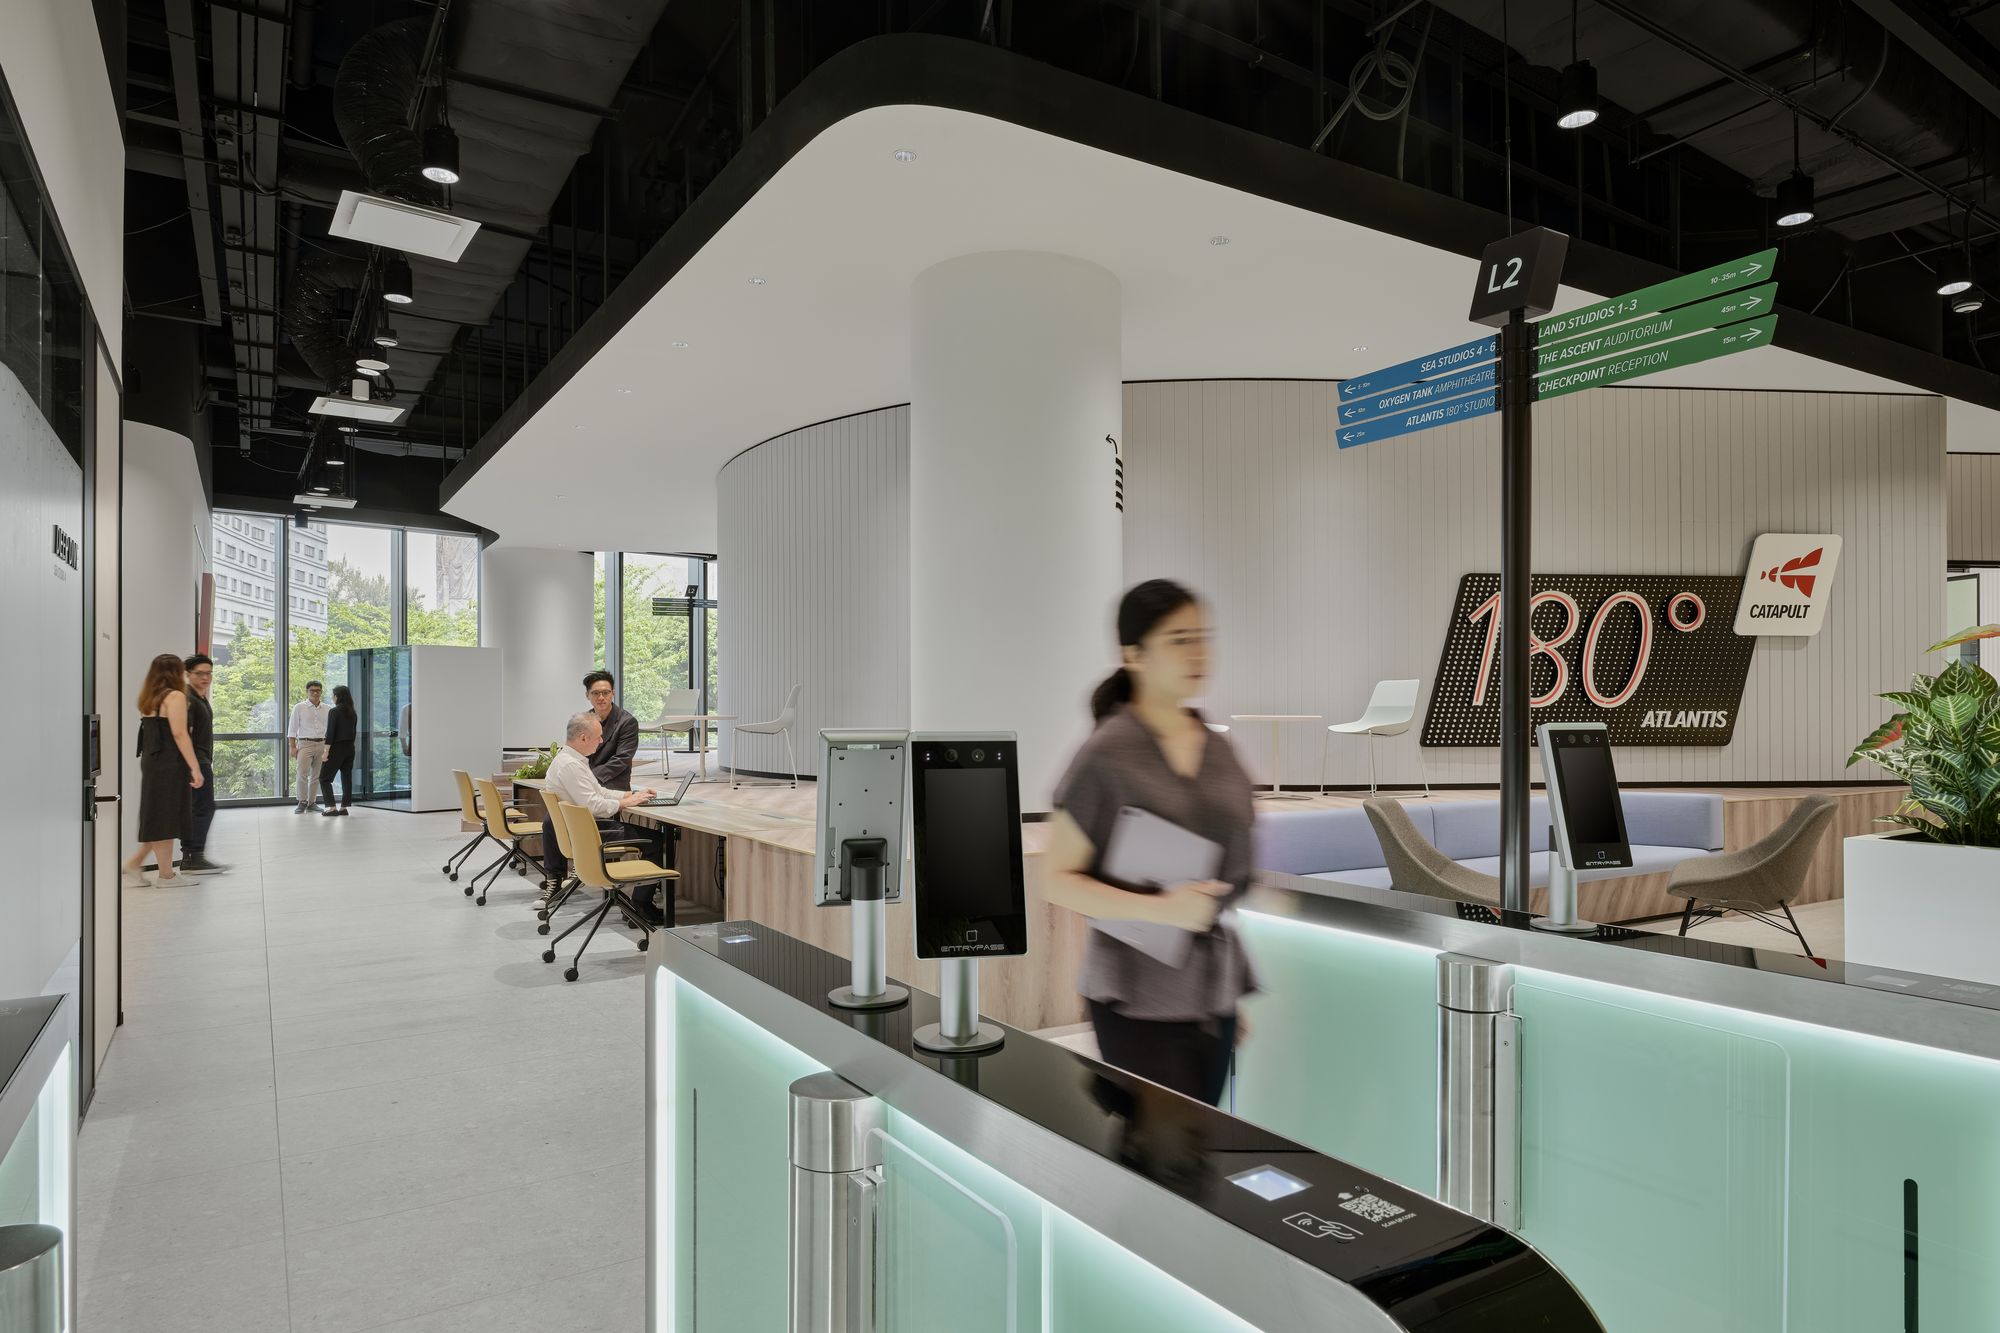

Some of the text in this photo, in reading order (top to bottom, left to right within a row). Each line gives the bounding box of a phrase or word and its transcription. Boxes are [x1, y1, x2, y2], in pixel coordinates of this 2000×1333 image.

[1487, 257, 1522, 294] L2
[1538, 321, 1566, 338] LAND
[1568, 305, 1615, 330] STUDIOS
[1721, 305, 1737, 313] 45m
[1538, 319, 1673, 365] THE ASCENT AUDITORIUM
[1723, 336, 1737, 344] 15m
[1420, 362, 1436, 373] SEA
[1438, 348, 1475, 368] STUDIOS
[1538, 350, 1669, 393] CHECKPOINT RECEPTION
[1378, 369, 1496, 409] OXYGEN TANK AMPHITHEATRE
[1405, 395, 1496, 428] ATLANTIS 180° STUDIO
[1749, 604, 1811, 619] CATAPULT
[1640, 710, 1728, 728] ATLANTIS
[940, 944, 1005, 952] ENTRYPASS
